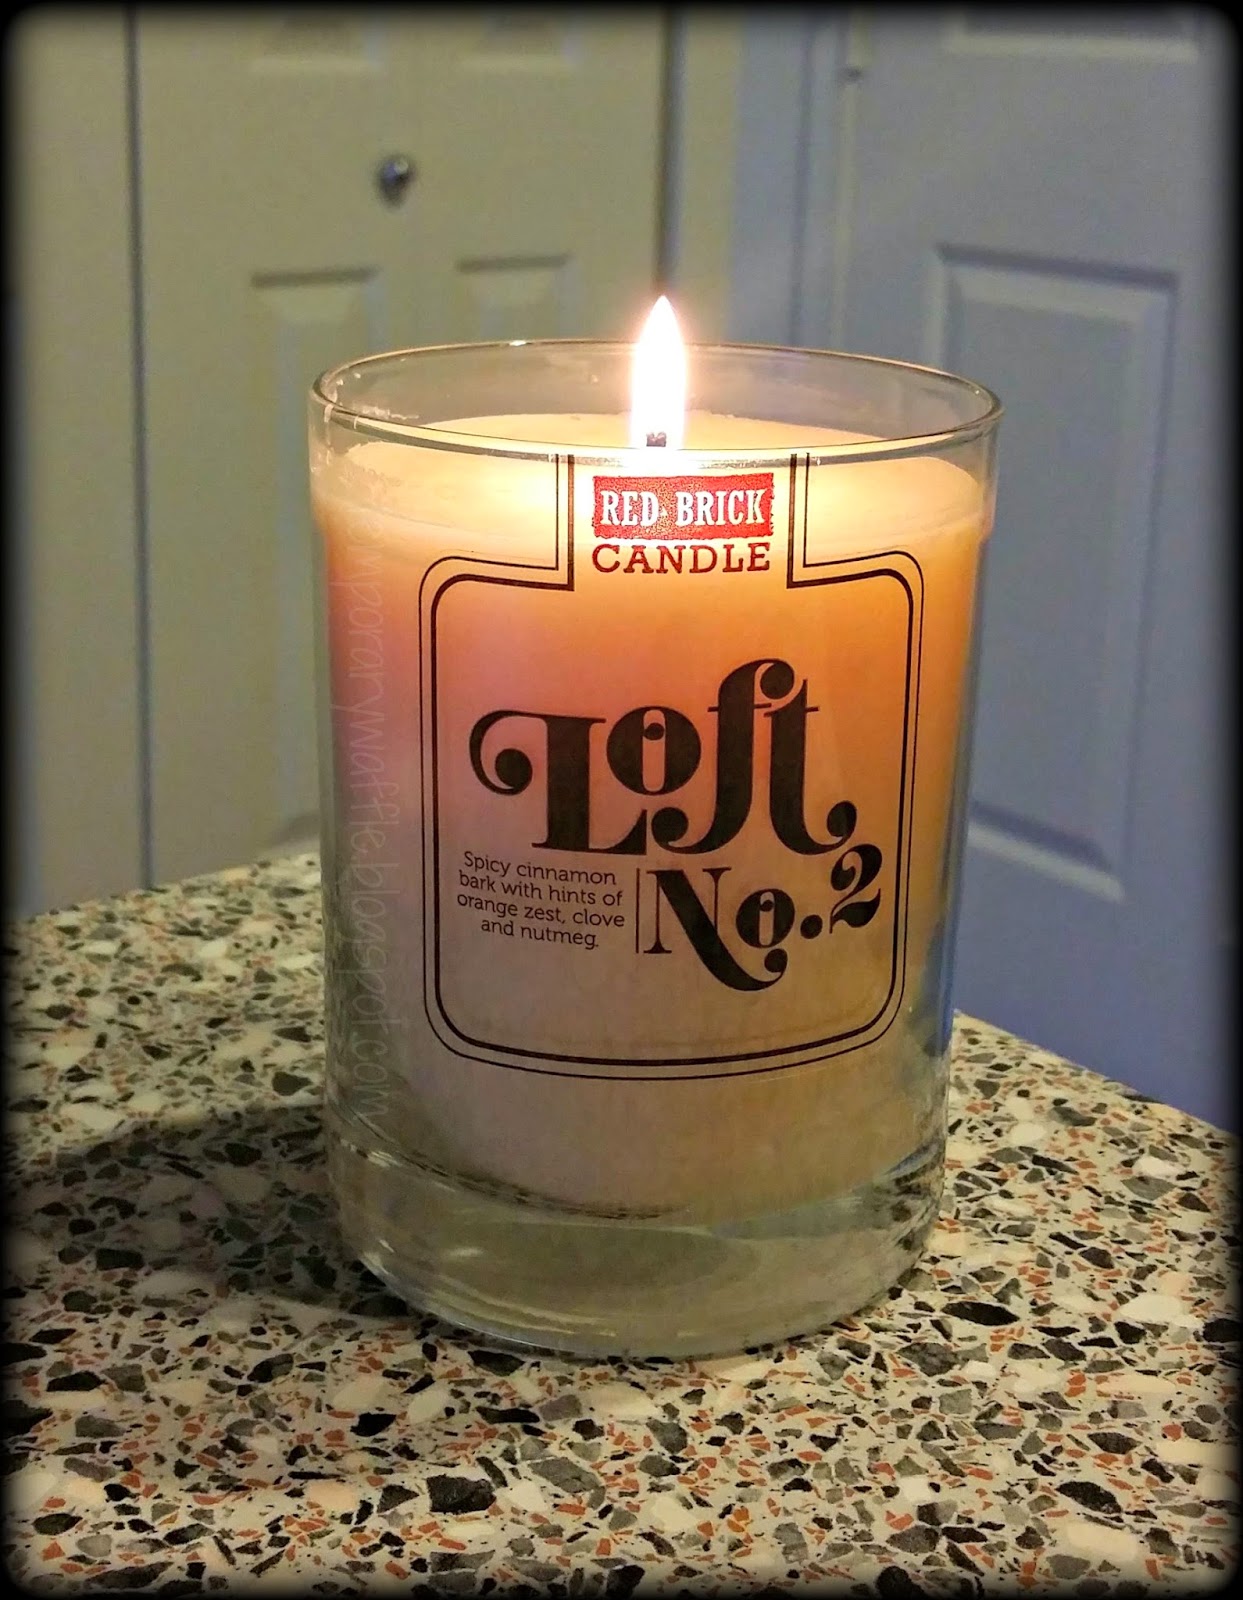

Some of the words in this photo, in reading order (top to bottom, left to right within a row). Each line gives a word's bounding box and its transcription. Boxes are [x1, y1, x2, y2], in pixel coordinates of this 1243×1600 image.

[599, 490, 659, 526] RED
[675, 489, 766, 526] BRICK
[592, 542, 770, 573] CANDLE
[469, 658, 857, 855] Loft
[464, 851, 511, 877] Spicy
[516, 862, 616, 885] cinnamon
[459, 870, 496, 893] bark
[501, 881, 542, 900] with
[549, 885, 596, 904] hints
[602, 890, 623, 907] of
[457, 893, 518, 917] orange
[524, 905, 566, 924] zest,
[573, 908, 625, 927] clove
[481, 919, 514, 937] and
[520, 924, 599, 950] nutmeg.
